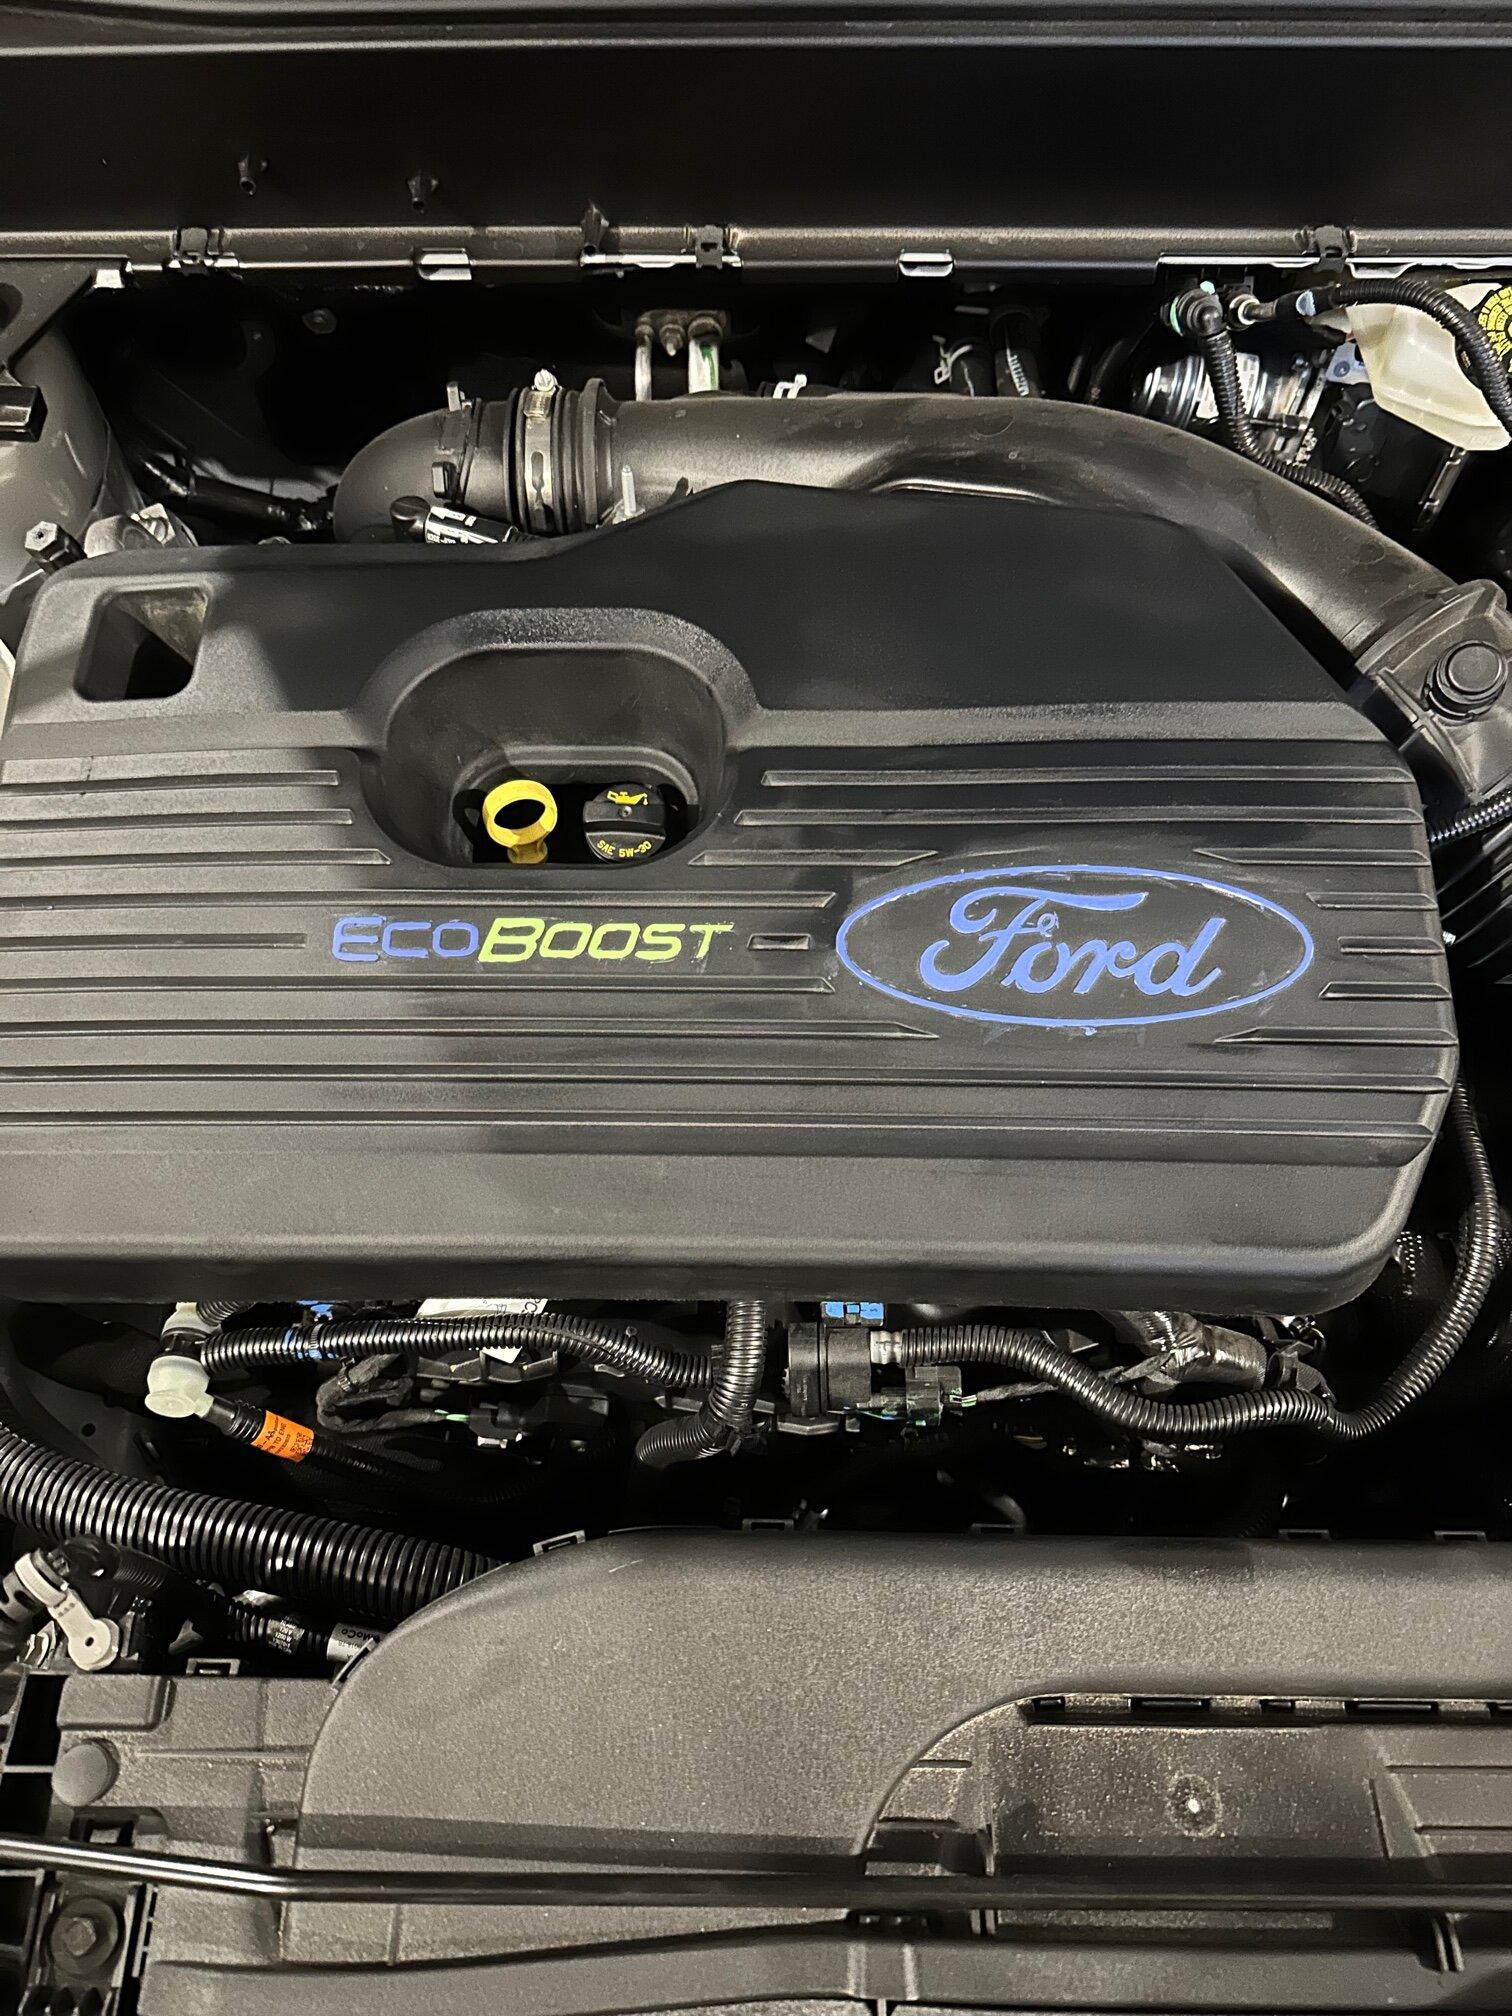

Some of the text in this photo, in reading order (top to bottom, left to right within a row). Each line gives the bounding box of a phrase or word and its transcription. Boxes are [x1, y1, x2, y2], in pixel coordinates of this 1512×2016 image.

[597, 840, 652, 858] SAE 5W-30
[919, 886, 1227, 997] Ford
